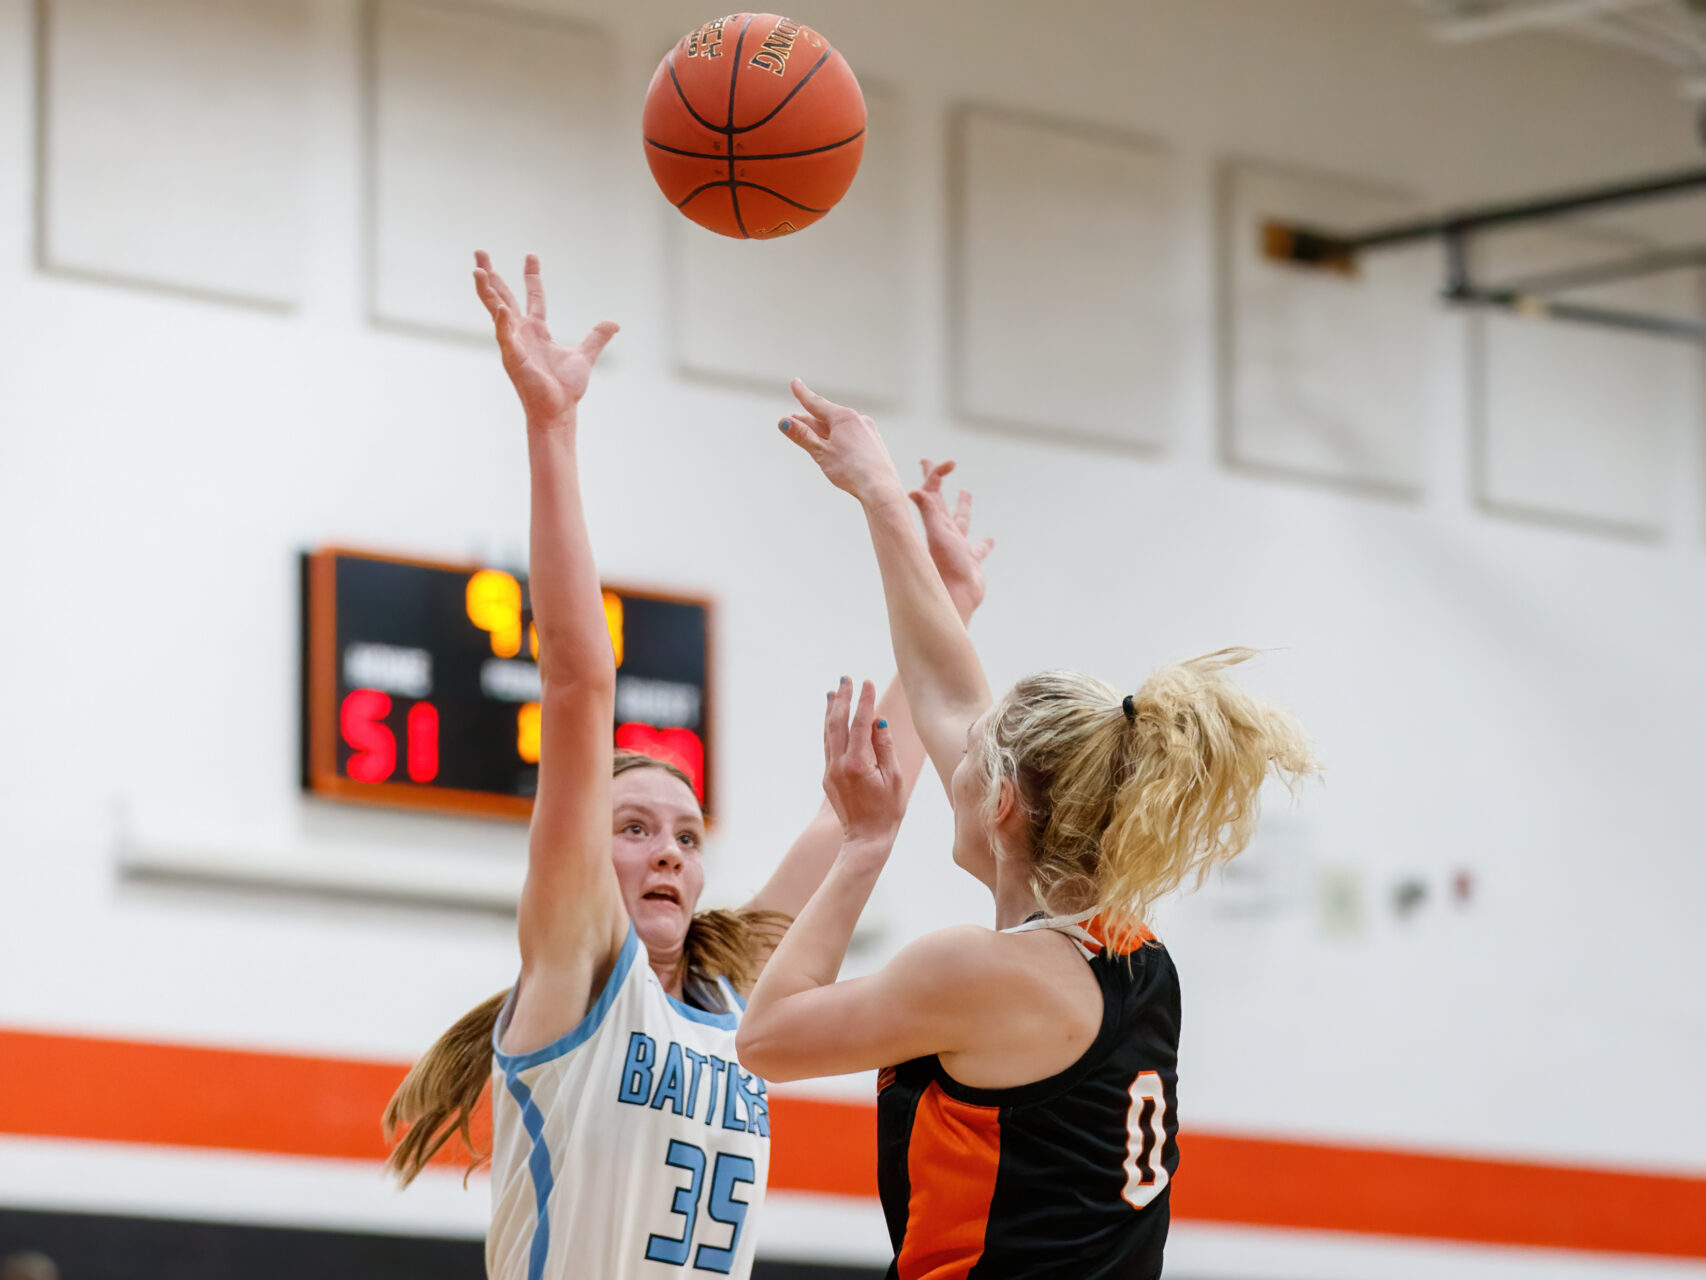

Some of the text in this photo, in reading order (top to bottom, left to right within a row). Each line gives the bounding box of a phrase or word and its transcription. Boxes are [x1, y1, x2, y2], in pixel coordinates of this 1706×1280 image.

[340, 688, 440, 784] 51
[644, 1138, 756, 1275] 35
[1120, 1069, 1170, 1211] 0
